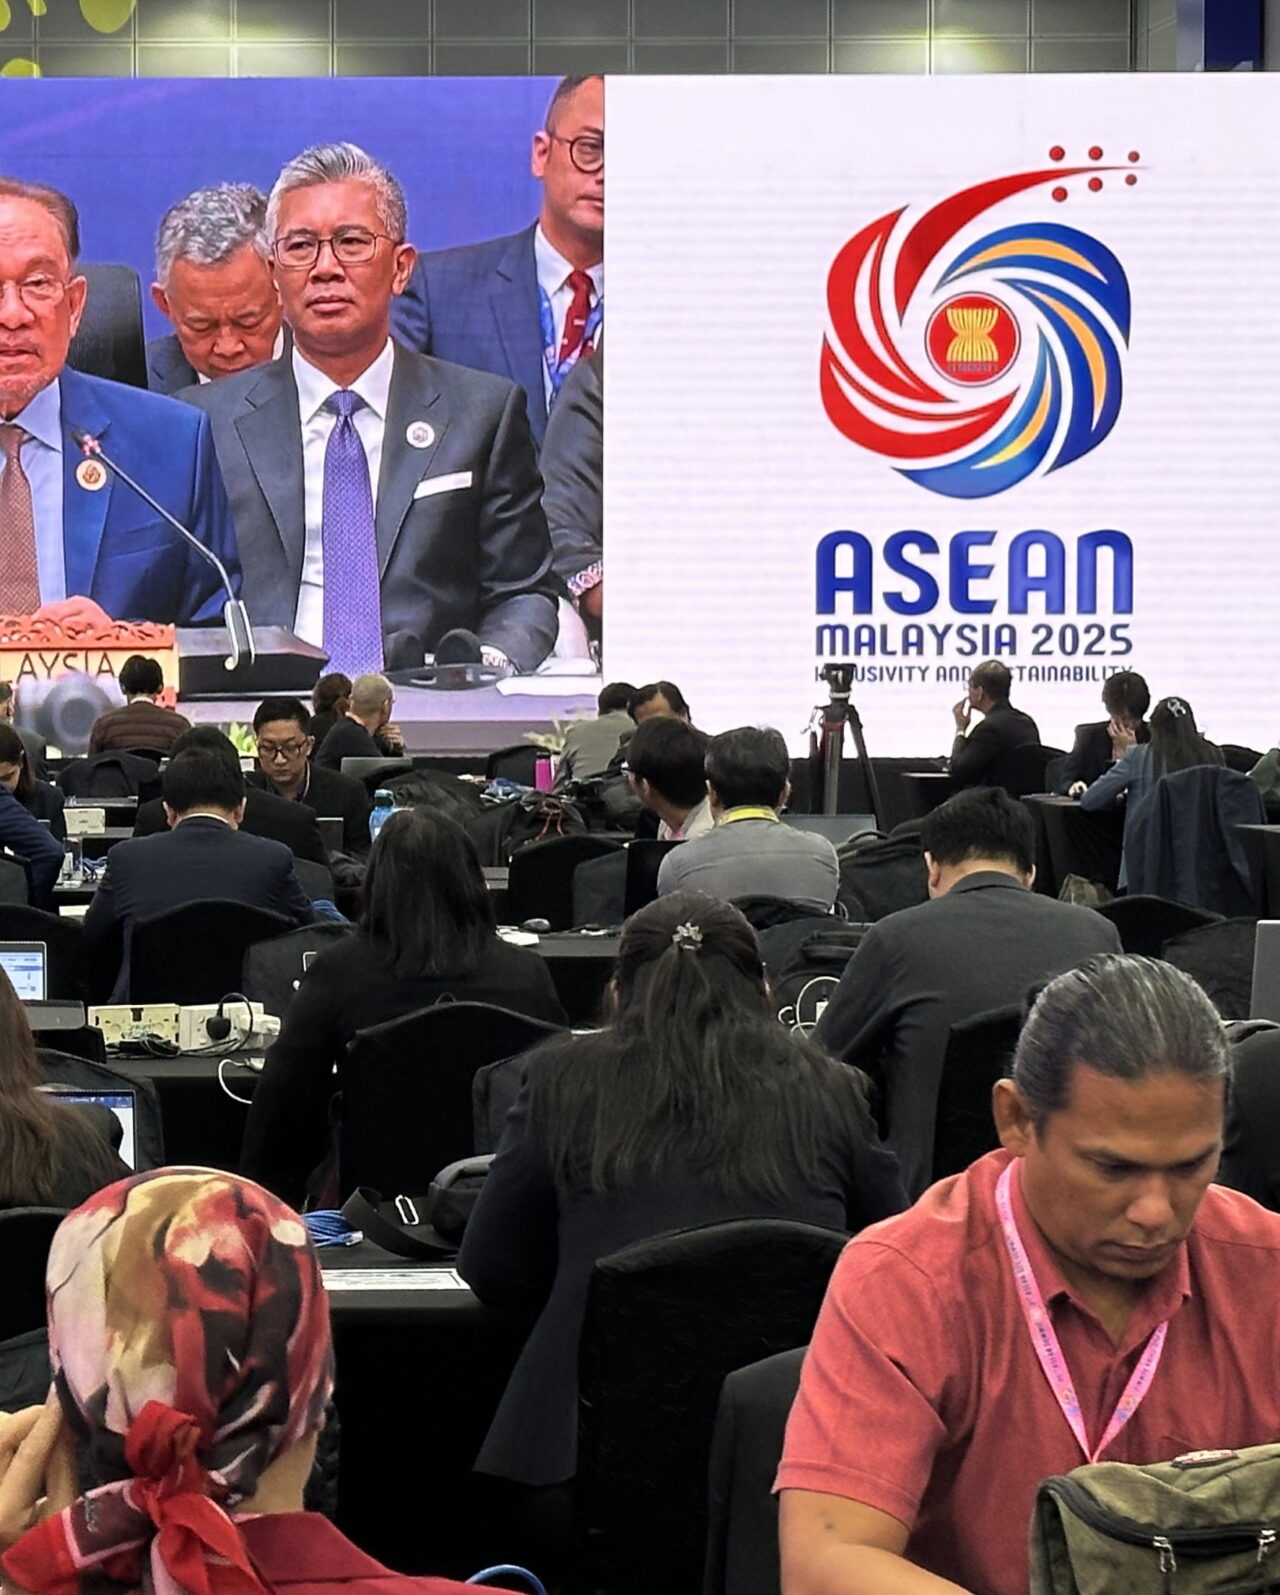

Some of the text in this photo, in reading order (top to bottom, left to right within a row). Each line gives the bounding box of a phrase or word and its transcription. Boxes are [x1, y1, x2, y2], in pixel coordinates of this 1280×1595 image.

[815, 529, 1134, 617] ASEAN
[815, 623, 1134, 656] MALAYSIA 2025
[815, 665, 930, 682] IUSIVITY
[935, 665, 972, 682] AND
